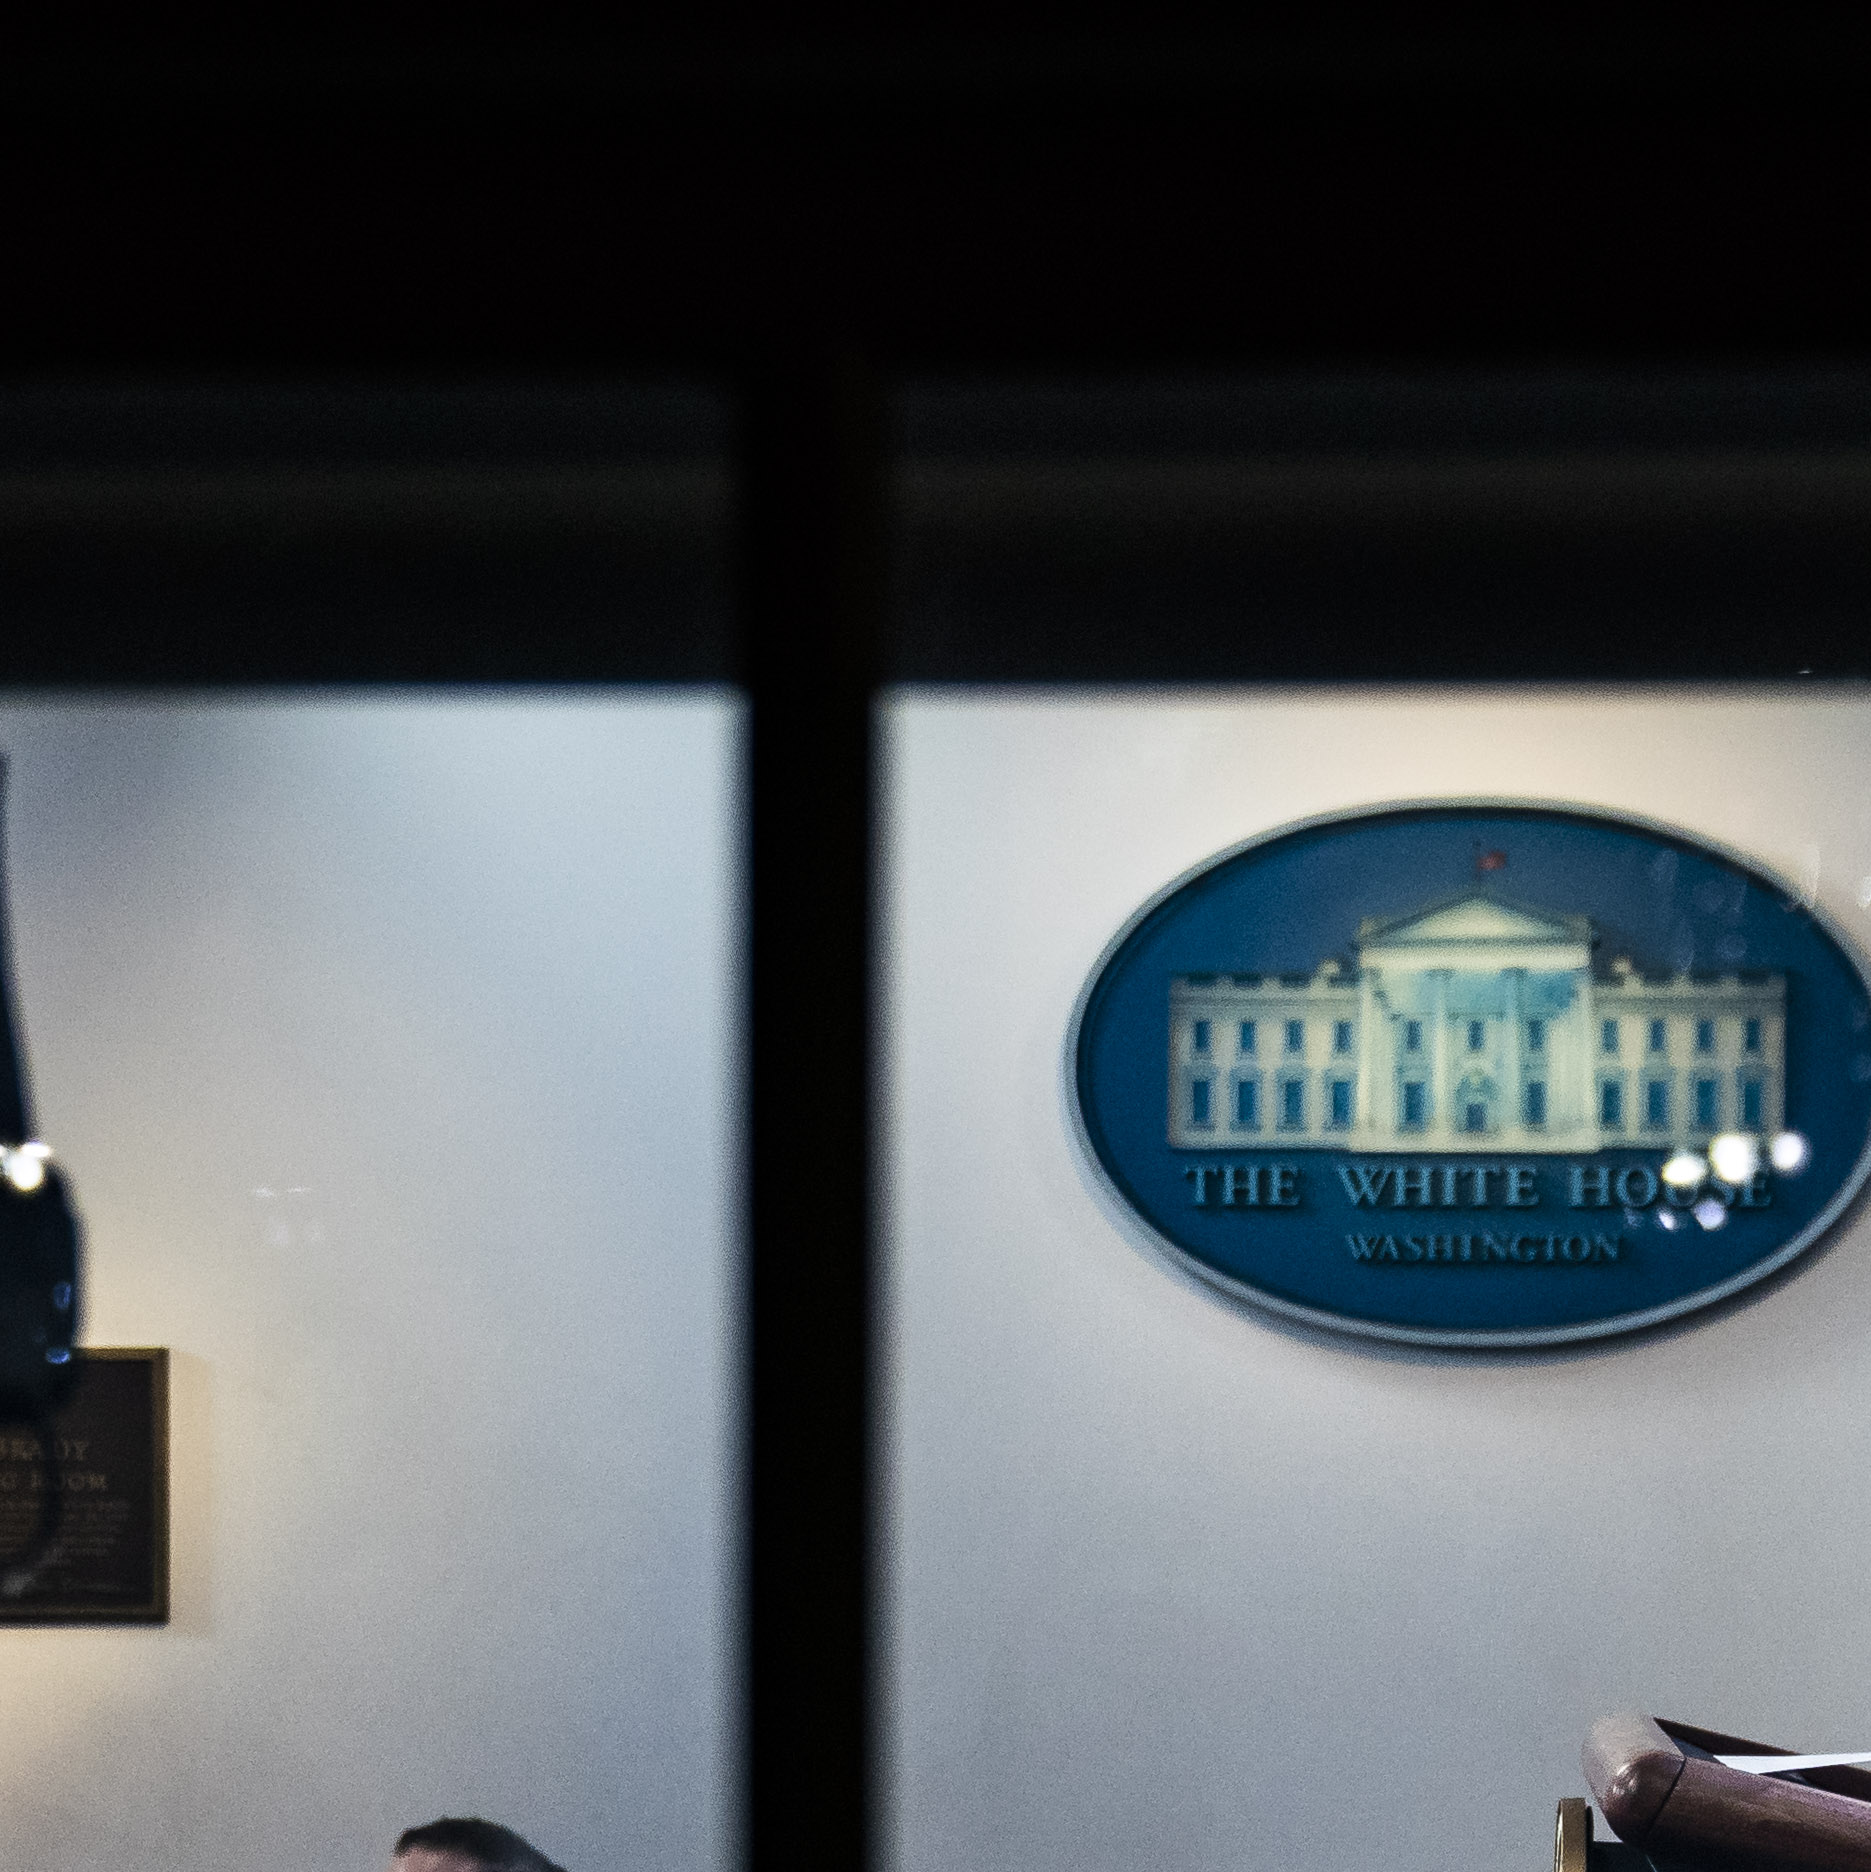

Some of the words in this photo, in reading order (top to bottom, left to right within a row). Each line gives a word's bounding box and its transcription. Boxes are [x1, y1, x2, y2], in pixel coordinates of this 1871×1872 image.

[1185, 1164, 1302, 1207] THE
[1337, 1164, 1539, 1207] WHITE
[1345, 1232, 1624, 1263] WASHINGTON
